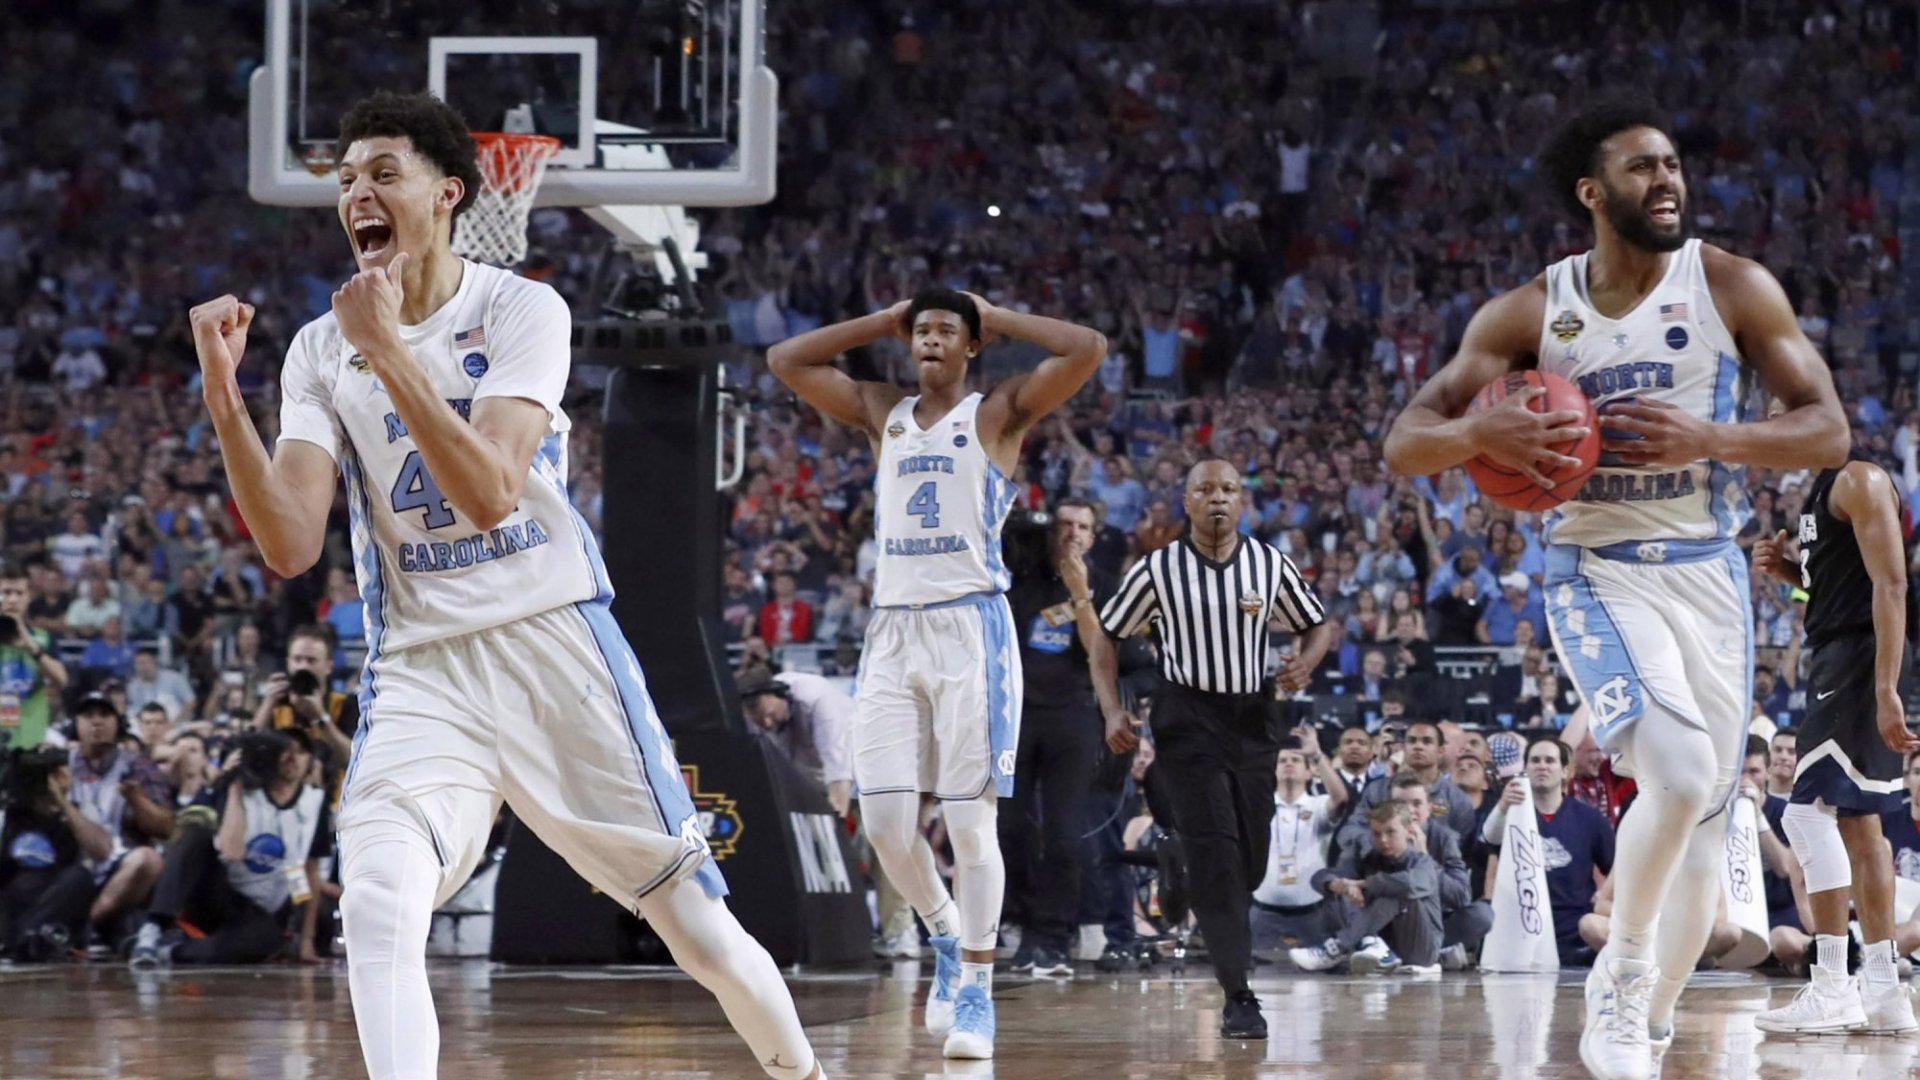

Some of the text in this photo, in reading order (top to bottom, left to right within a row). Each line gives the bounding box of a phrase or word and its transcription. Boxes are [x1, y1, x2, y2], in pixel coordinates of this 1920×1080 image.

[1577, 361, 1674, 399] NORTH
[897, 455, 954, 478] NORTH
[906, 481, 939, 529] 4
[399, 518, 548, 573] CAROLINA
[885, 534, 970, 557] CAROLINA
[1509, 825, 1543, 936] ZAGS
